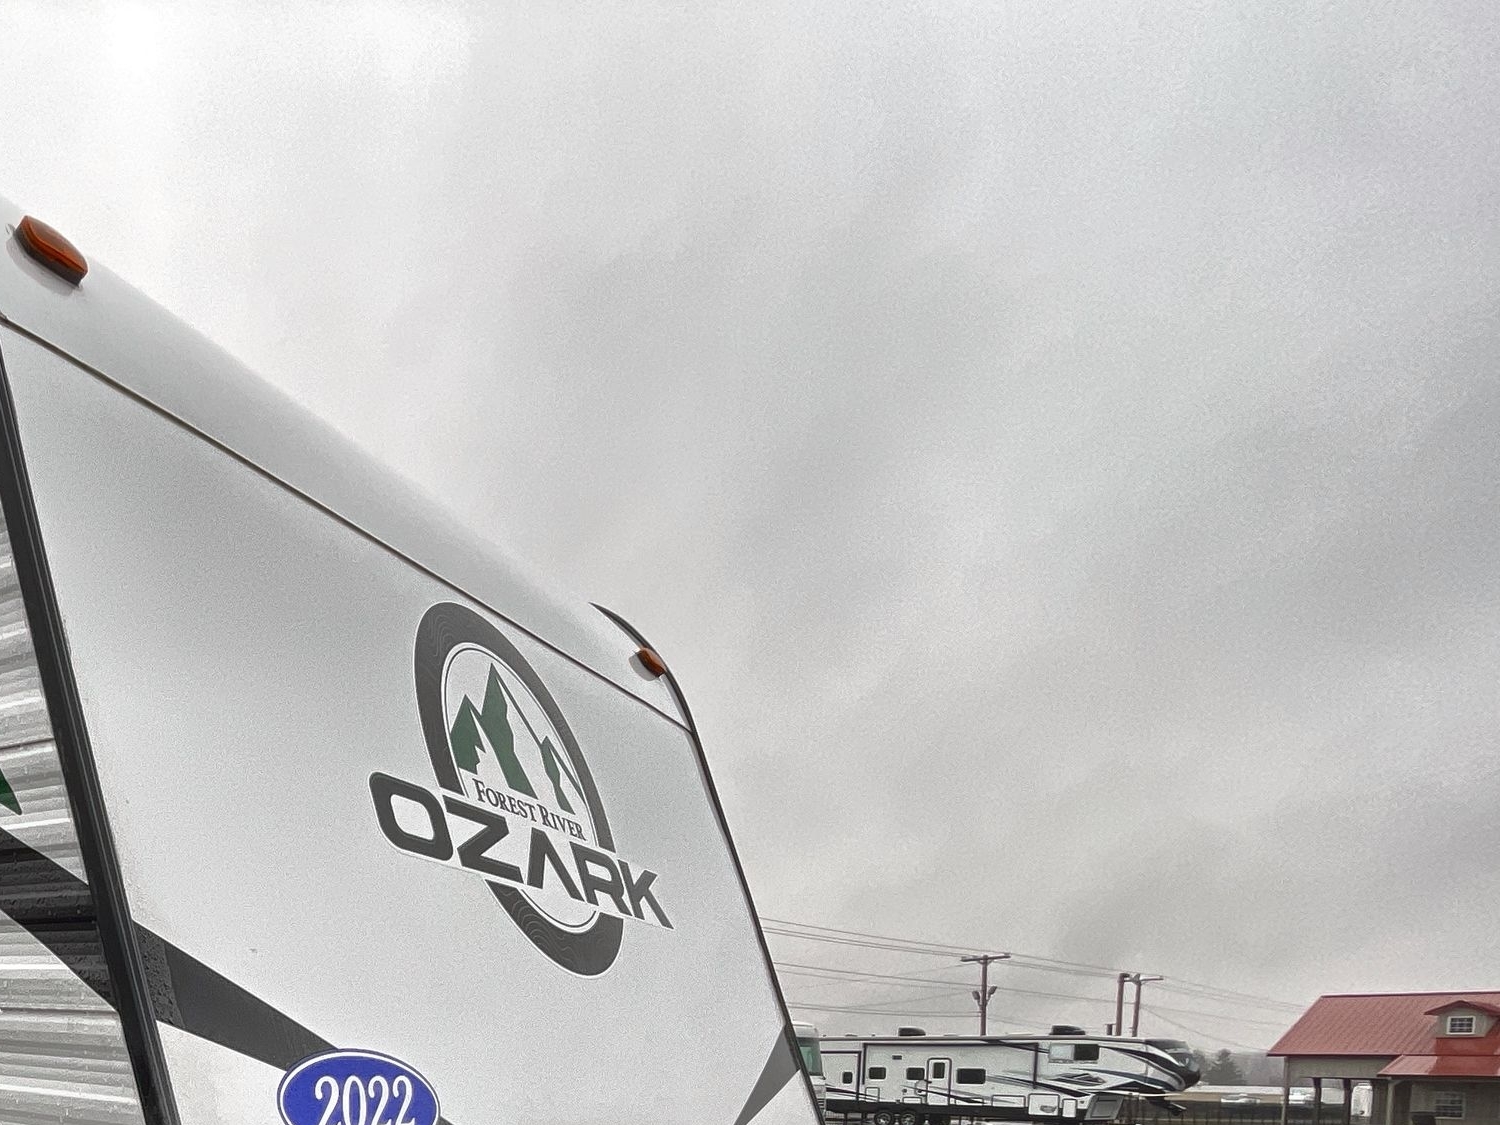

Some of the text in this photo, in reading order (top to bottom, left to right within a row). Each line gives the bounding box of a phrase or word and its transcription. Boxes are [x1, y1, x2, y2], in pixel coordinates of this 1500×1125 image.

[369, 772, 674, 930] OZARK
[472, 778, 587, 841] FOREST RIVER
